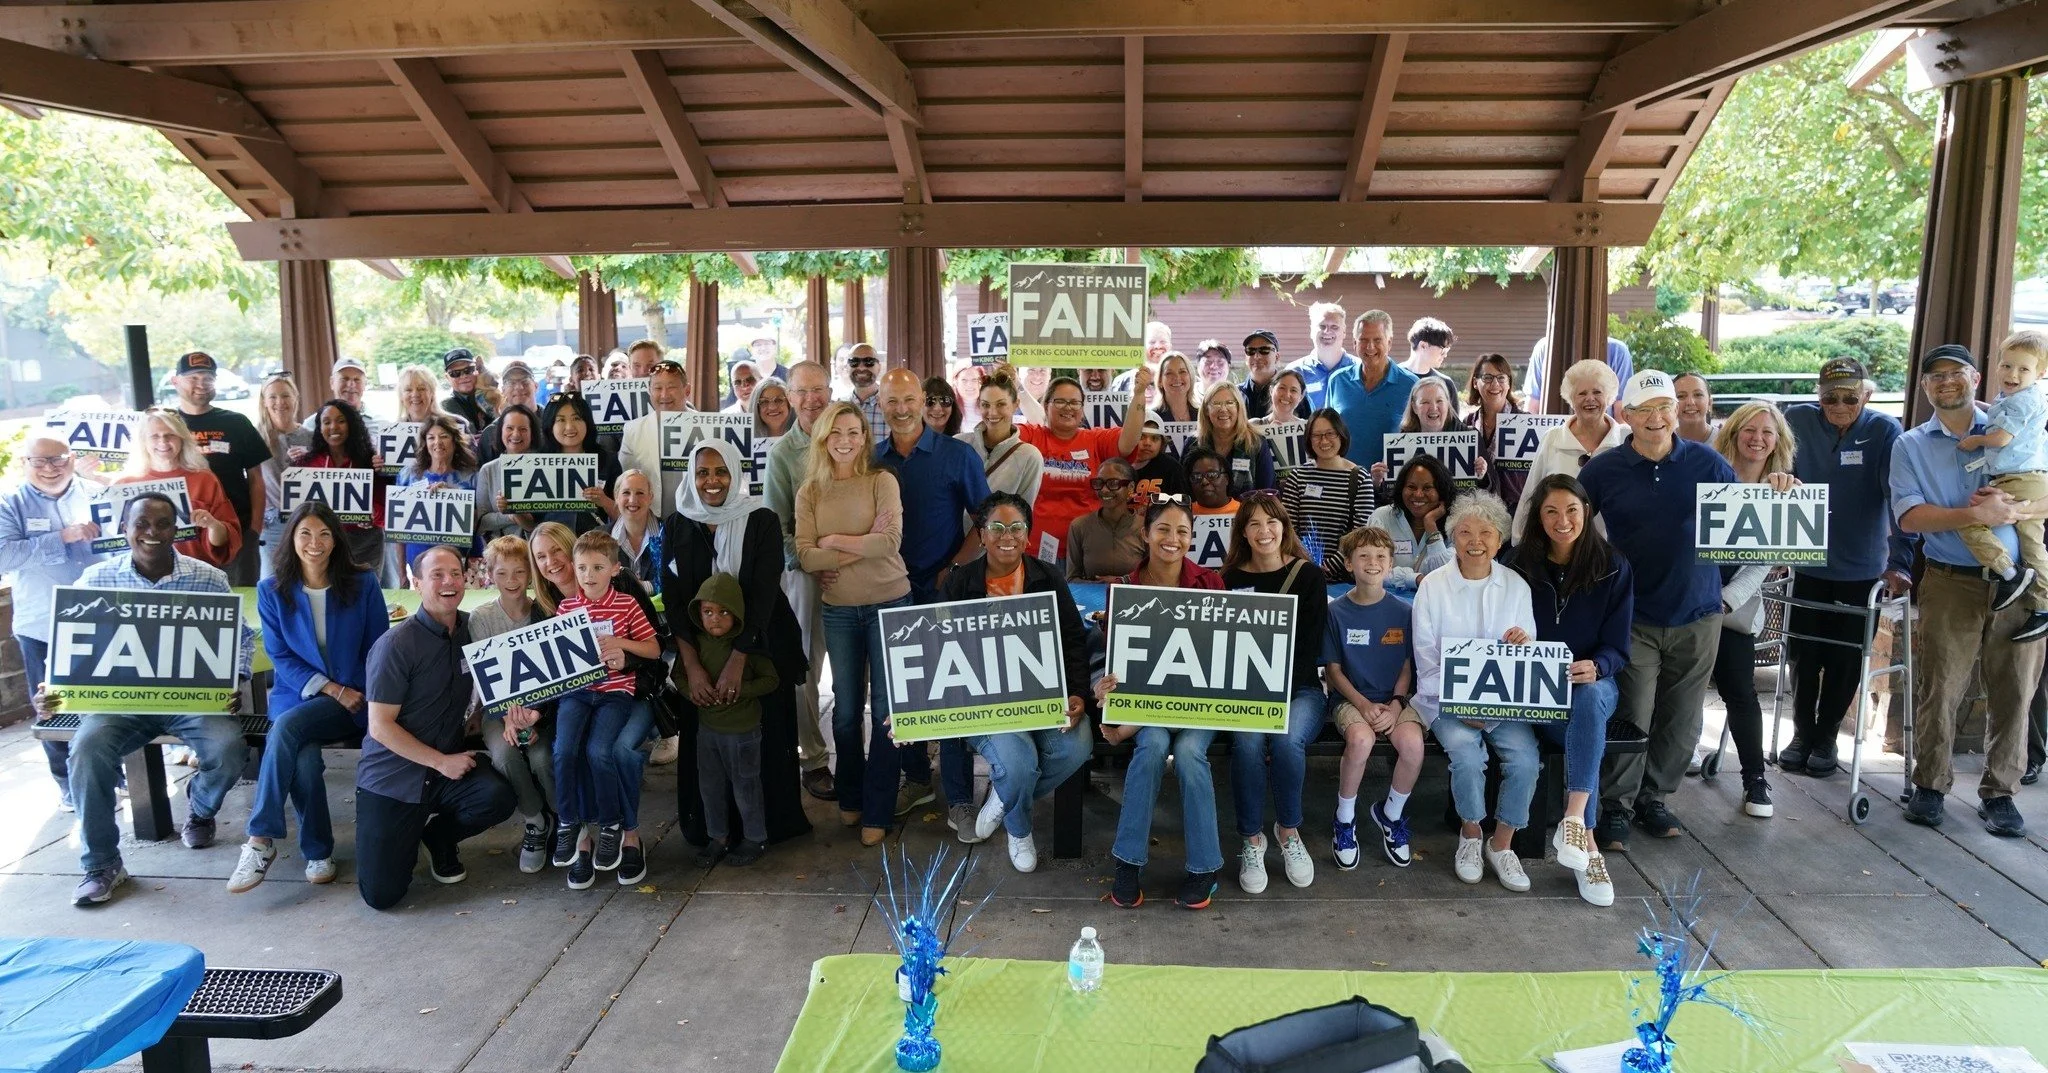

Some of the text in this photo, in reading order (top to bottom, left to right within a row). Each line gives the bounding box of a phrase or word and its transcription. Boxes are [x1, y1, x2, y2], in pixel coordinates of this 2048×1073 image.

[1056, 275, 1142, 288] STEFFANIE
[1012, 292, 1143, 339] FAIN
[1011, 348, 1142, 358] FOR KING COUNTY COUNCIL (D)
[1639, 378, 1664, 387] FAIN
[1087, 394, 1129, 403] EFFANIE
[693, 415, 752, 425] STEFFANIE
[1416, 434, 1476, 445] STEFFANIE
[534, 457, 596, 466] STEFFANIE
[312, 471, 371, 480] STEFFANIE
[503, 468, 596, 499] FAIN
[283, 481, 371, 511] FAIN
[416, 491, 473, 501] STEFFANIE
[1742, 488, 1826, 500] STEFFANIE
[339, 514, 370, 522] COUNCIL
[387, 499, 472, 533] FAIN
[1699, 502, 1825, 546] FAIN
[104, 539, 127, 549] KING
[412, 534, 441, 542] COUNTY
[441, 535, 472, 544] COUNCIL
[1710, 551, 1736, 560] KING
[1738, 552, 1779, 560] COUNTY
[1781, 552, 1826, 561] COUNCIL
[119, 603, 234, 621] STEFFANIE
[1173, 604, 1288, 626] STEFFANIE
[941, 608, 1051, 635] STEFFANIE
[507, 613, 588, 648] STEFFANIE
[53, 621, 235, 680] FAIN
[1112, 624, 1288, 693] FAIN
[1485, 644, 1571, 659] STEFFANIE
[472, 626, 602, 702] FAIN
[888, 630, 1059, 704] FAIN
[1442, 657, 1569, 706] FAIN
[78, 690, 109, 699] KING
[111, 691, 160, 700] COUNTY
[163, 691, 212, 701] COUNCIL
[488, 707, 500, 715] FOR
[498, 698, 524, 713] KING
[525, 683, 564, 702] COUNTY
[565, 669, 609, 688] COUNCIL
[896, 717, 918, 727] FOR
[919, 714, 946, 725] KING
[948, 709, 993, 722] COUNTY
[996, 705, 1045, 718] COUNCIL
[1047, 702, 1063, 716] (D)
[1109, 698, 1283, 718] FOR KING COUNTY COUNCIL (D)
[1453, 705, 1478, 715] KING
[1480, 706, 1522, 717] COUNTY
[1524, 708, 1569, 720] COUNCIL
